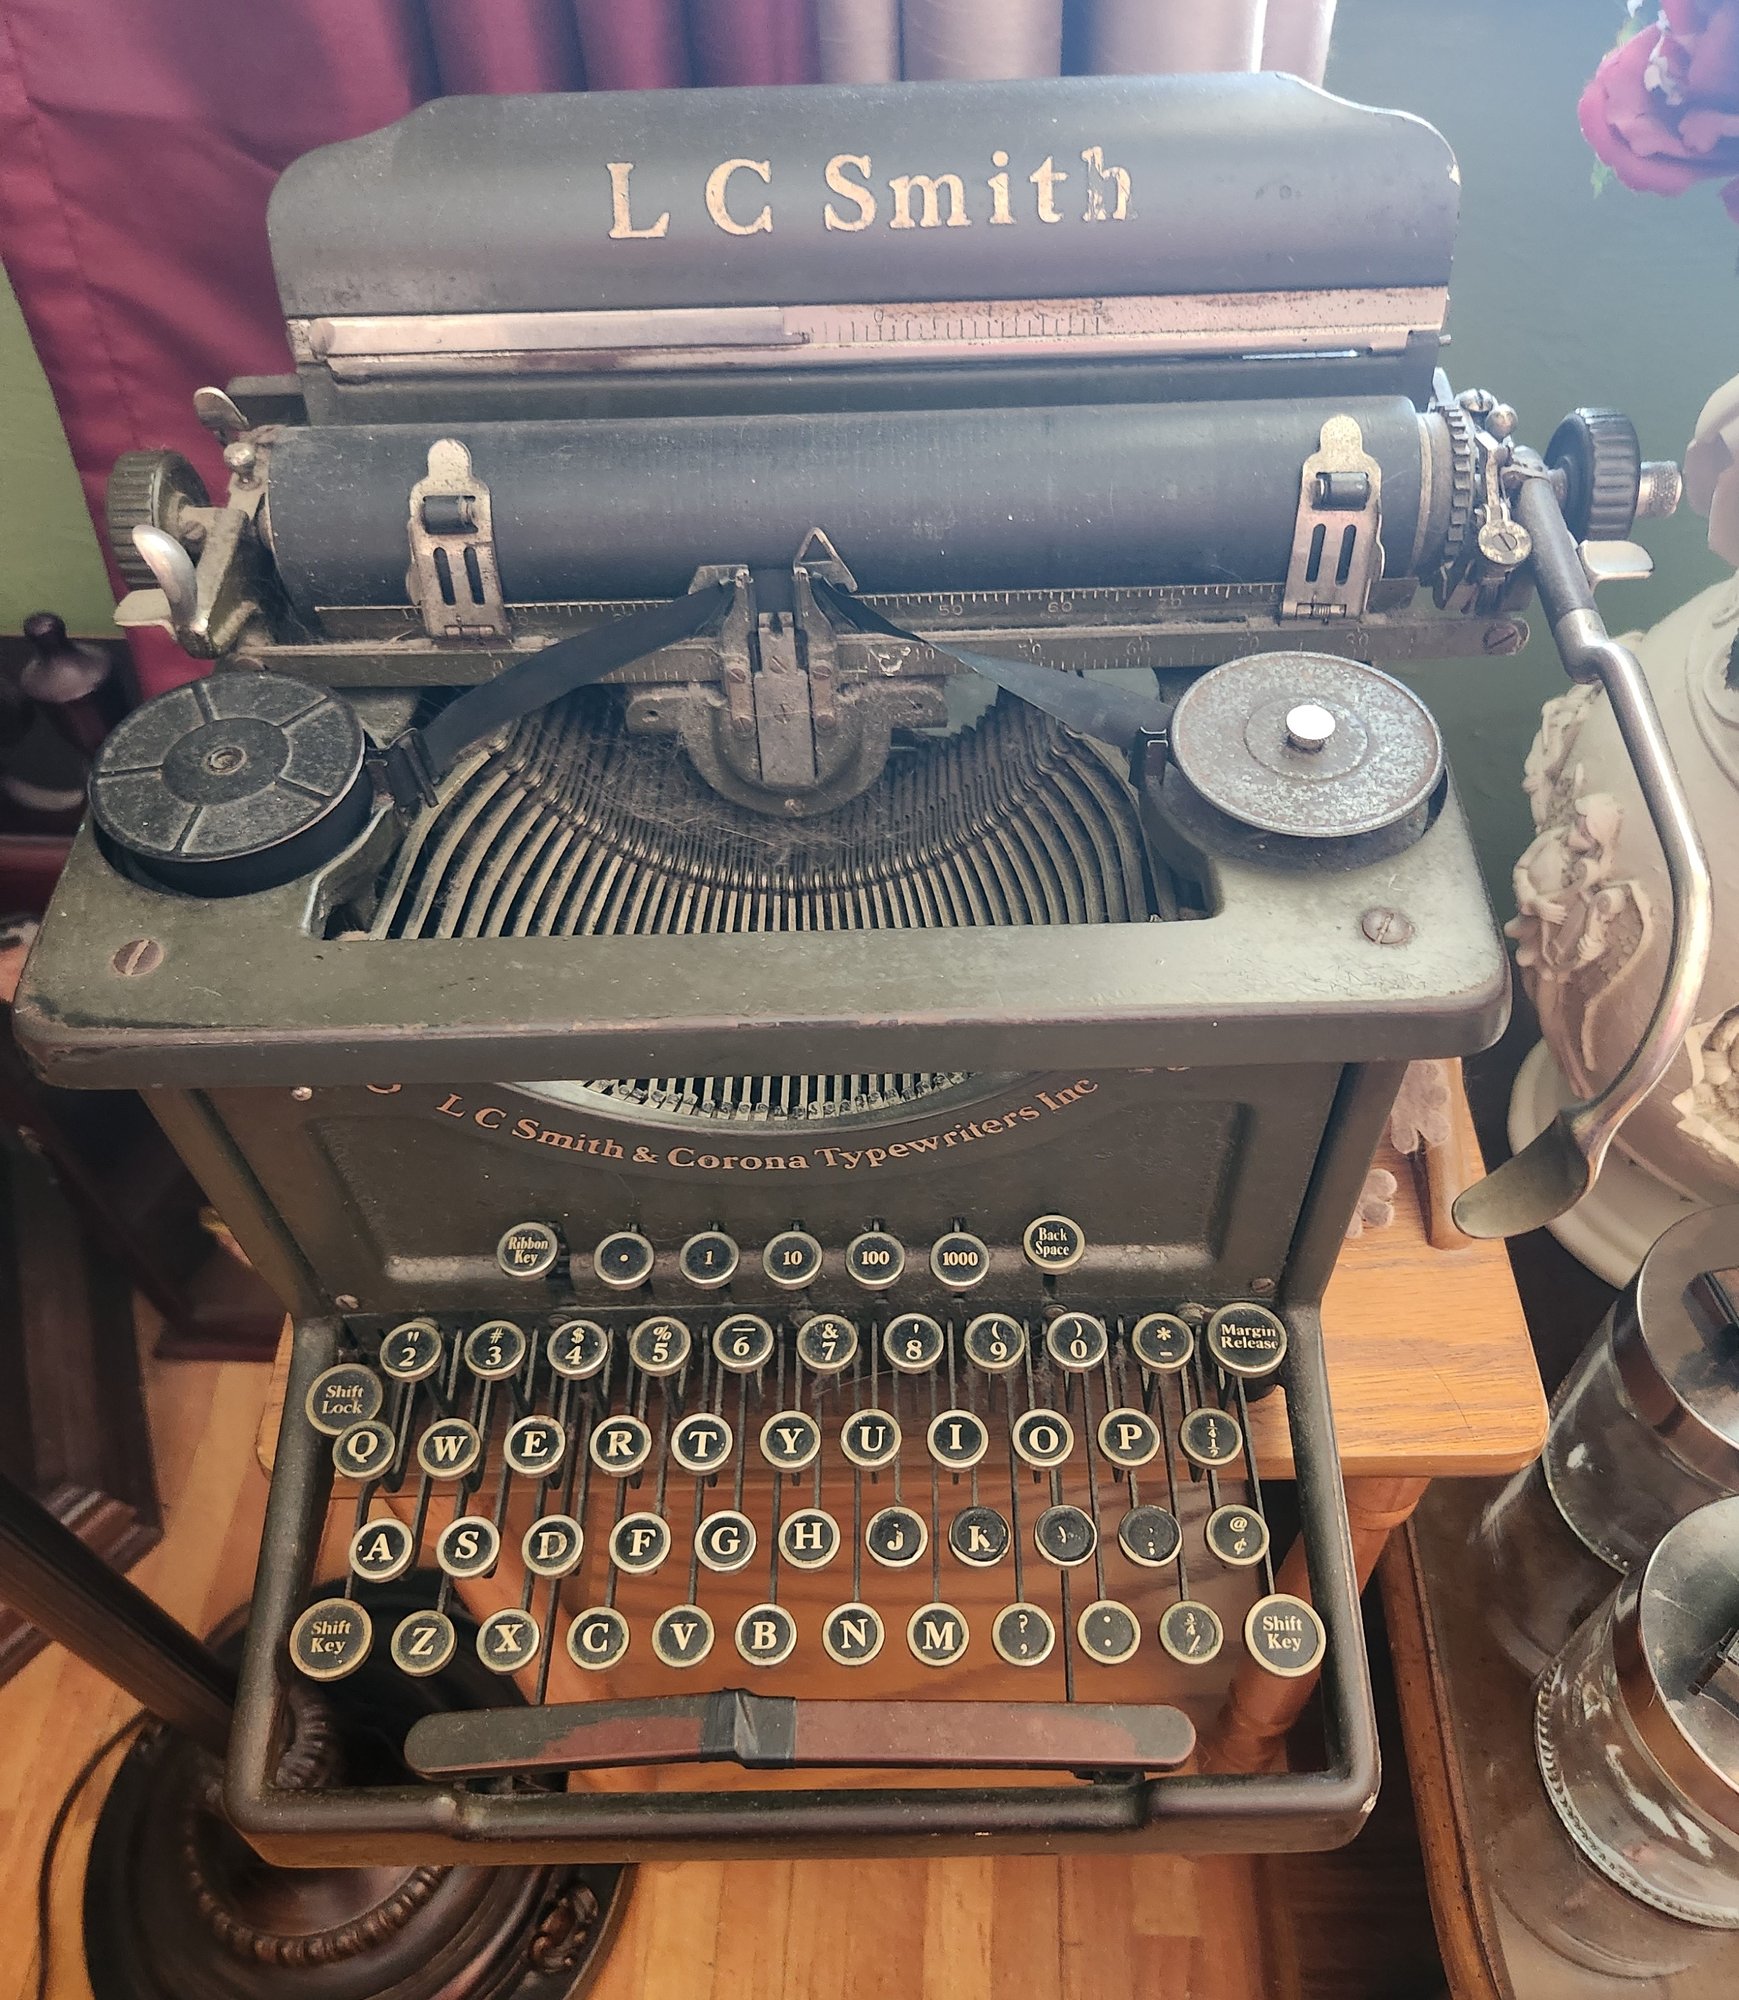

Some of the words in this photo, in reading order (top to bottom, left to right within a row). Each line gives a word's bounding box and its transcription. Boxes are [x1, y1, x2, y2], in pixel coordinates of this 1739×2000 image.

[607, 162, 670, 239] L
[705, 158, 773, 236] C
[824, 146, 1132, 232] Smith
[1048, 601, 1073, 613] 60
[436, 1093, 466, 1118] L
[475, 1107, 507, 1129] C
[512, 1118, 624, 1159] Smith
[632, 1146, 659, 1164] &
[667, 1147, 809, 1171] Corona
[814, 1105, 1041, 1169] Typewriters
[1035, 1078, 1098, 1112] Inc
[508, 1236, 549, 1249] Ribbon
[1039, 1227, 1067, 1240] Back
[515, 1250, 538, 1266] Key
[705, 1251, 712, 1264] 1
[783, 1251, 802, 1265] 10
[862, 1251, 889, 1264] 100
[1036, 1241, 1069, 1257] Space
[943, 1252, 978, 1266] 1000
[408, 1332, 419, 1341] "
[490, 1328, 503, 1343] #
[571, 1328, 584, 1343] $
[653, 1325, 671, 1341] %
[822, 1324, 838, 1338] &
[1074, 1320, 1082, 1337] )
[1222, 1324, 1276, 1338] Margin
[653, 1343, 668, 1362] 5
[733, 1337, 749, 1356] 6
[822, 1342, 835, 1360] 7
[906, 1340, 921, 1359] 8
[990, 1342, 1007, 1361] 9
[1071, 1340, 1087, 1358] 0
[1221, 1337, 1278, 1349] Release
[399, 1347, 415, 1366] 2
[486, 1346, 501, 1365] 3
[565, 1346, 582, 1364] 4
[326, 1385, 363, 1398] Shift
[322, 1399, 362, 1414] Lock
[521, 1431, 548, 1456] E
[607, 1431, 634, 1456] R
[689, 1432, 717, 1457] T
[777, 1428, 804, 1453] Y
[860, 1427, 885, 1451] U
[950, 1424, 962, 1449] I
[1030, 1426, 1058, 1453] O
[1117, 1424, 1142, 1449] P
[347, 1431, 377, 1463] Q
[433, 1436, 468, 1461] W
[1230, 1517, 1247, 1532] @
[455, 1531, 478, 1558] S
[537, 1532, 567, 1559] D
[629, 1530, 656, 1556] F
[712, 1527, 740, 1554] G
[794, 1523, 823, 1549] H
[886, 1523, 904, 1551] J
[968, 1525, 997, 1552] K
[363, 1534, 393, 1562] A
[1234, 1538, 1246, 1554] ¢
[311, 1620, 351, 1634] Shift
[1019, 1615, 1027, 1633] ?
[1263, 1616, 1302, 1631] Shift
[409, 1628, 436, 1655] Z
[494, 1624, 523, 1652] X
[583, 1623, 608, 1652] C
[670, 1623, 697, 1650] V
[751, 1622, 776, 1649] B
[840, 1619, 868, 1648] N
[922, 1622, 955, 1650] M
[1268, 1634, 1301, 1652] Key
[311, 1638, 345, 1654] Key
[1021, 1644, 1027, 1654] ,
[1188, 1635, 1200, 1654] /
